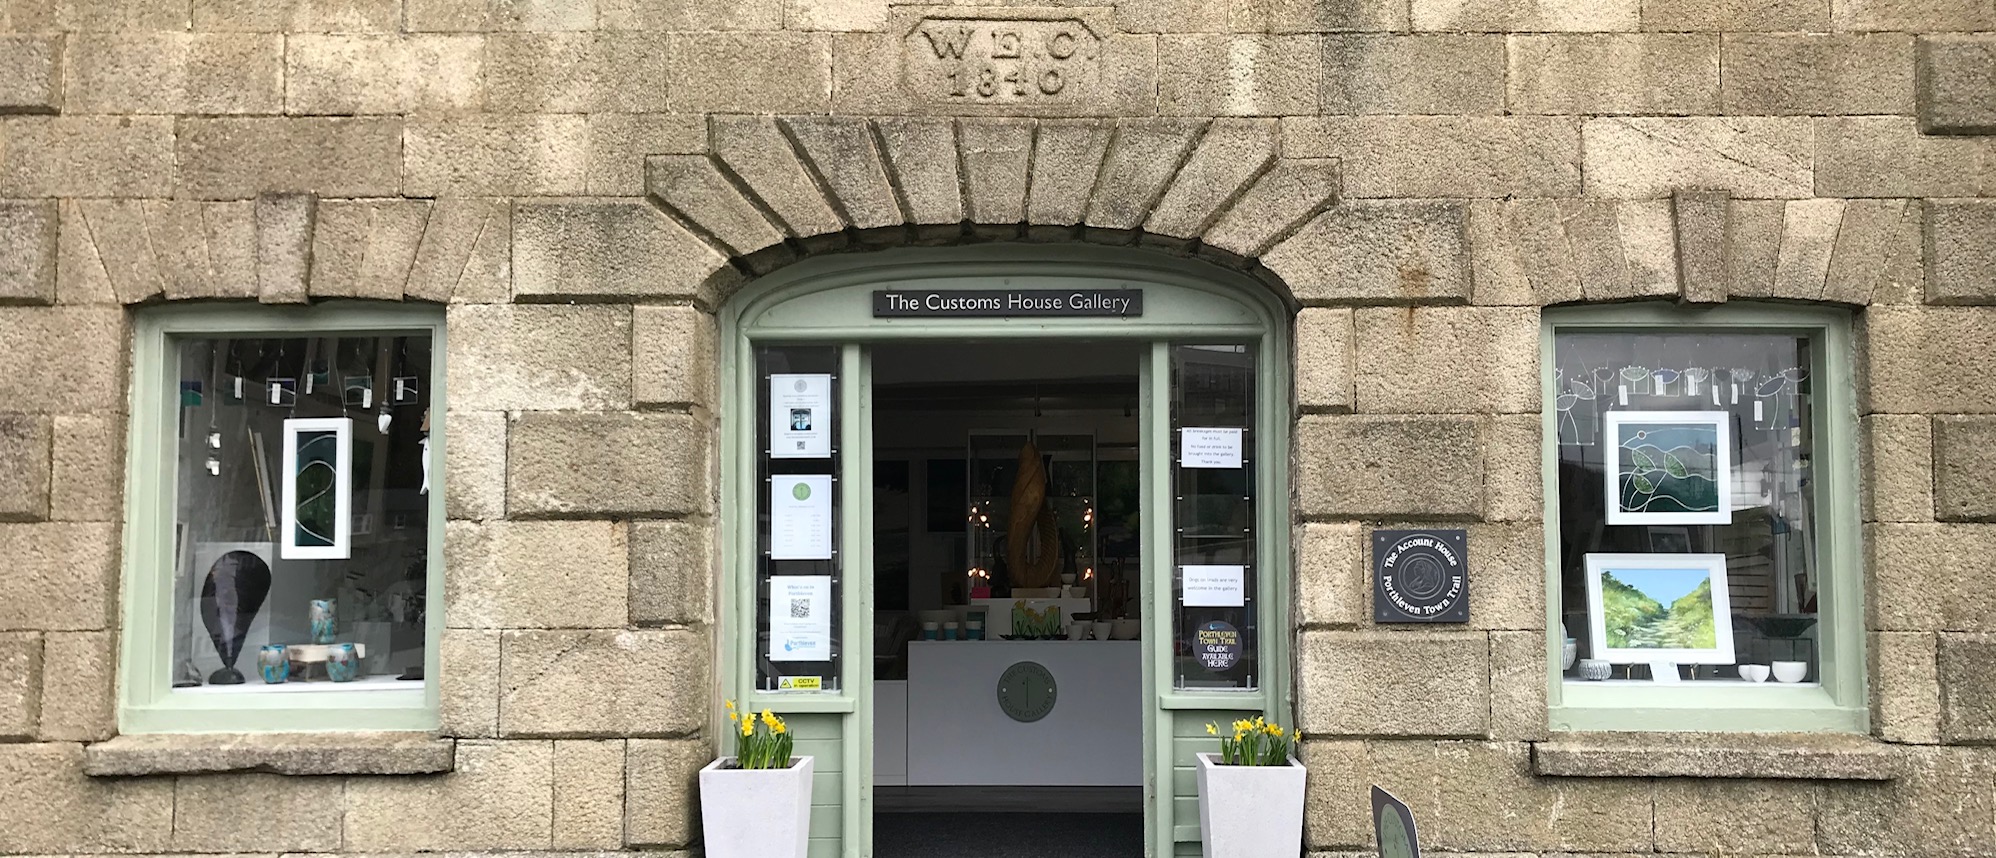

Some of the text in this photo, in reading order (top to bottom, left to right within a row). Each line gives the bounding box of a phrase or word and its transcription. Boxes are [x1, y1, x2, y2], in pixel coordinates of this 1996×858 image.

[948, 69, 1066, 97] 1840
[886, 294, 1130, 314] The Customs House Gallery
[1384, 538, 1458, 568] The Account House
[1383, 575, 1462, 614] Porthleven Town Trail
[1017, 666, 1050, 684] CUSTOMS
[1002, 694, 1053, 717] HOUSE GALLERY
